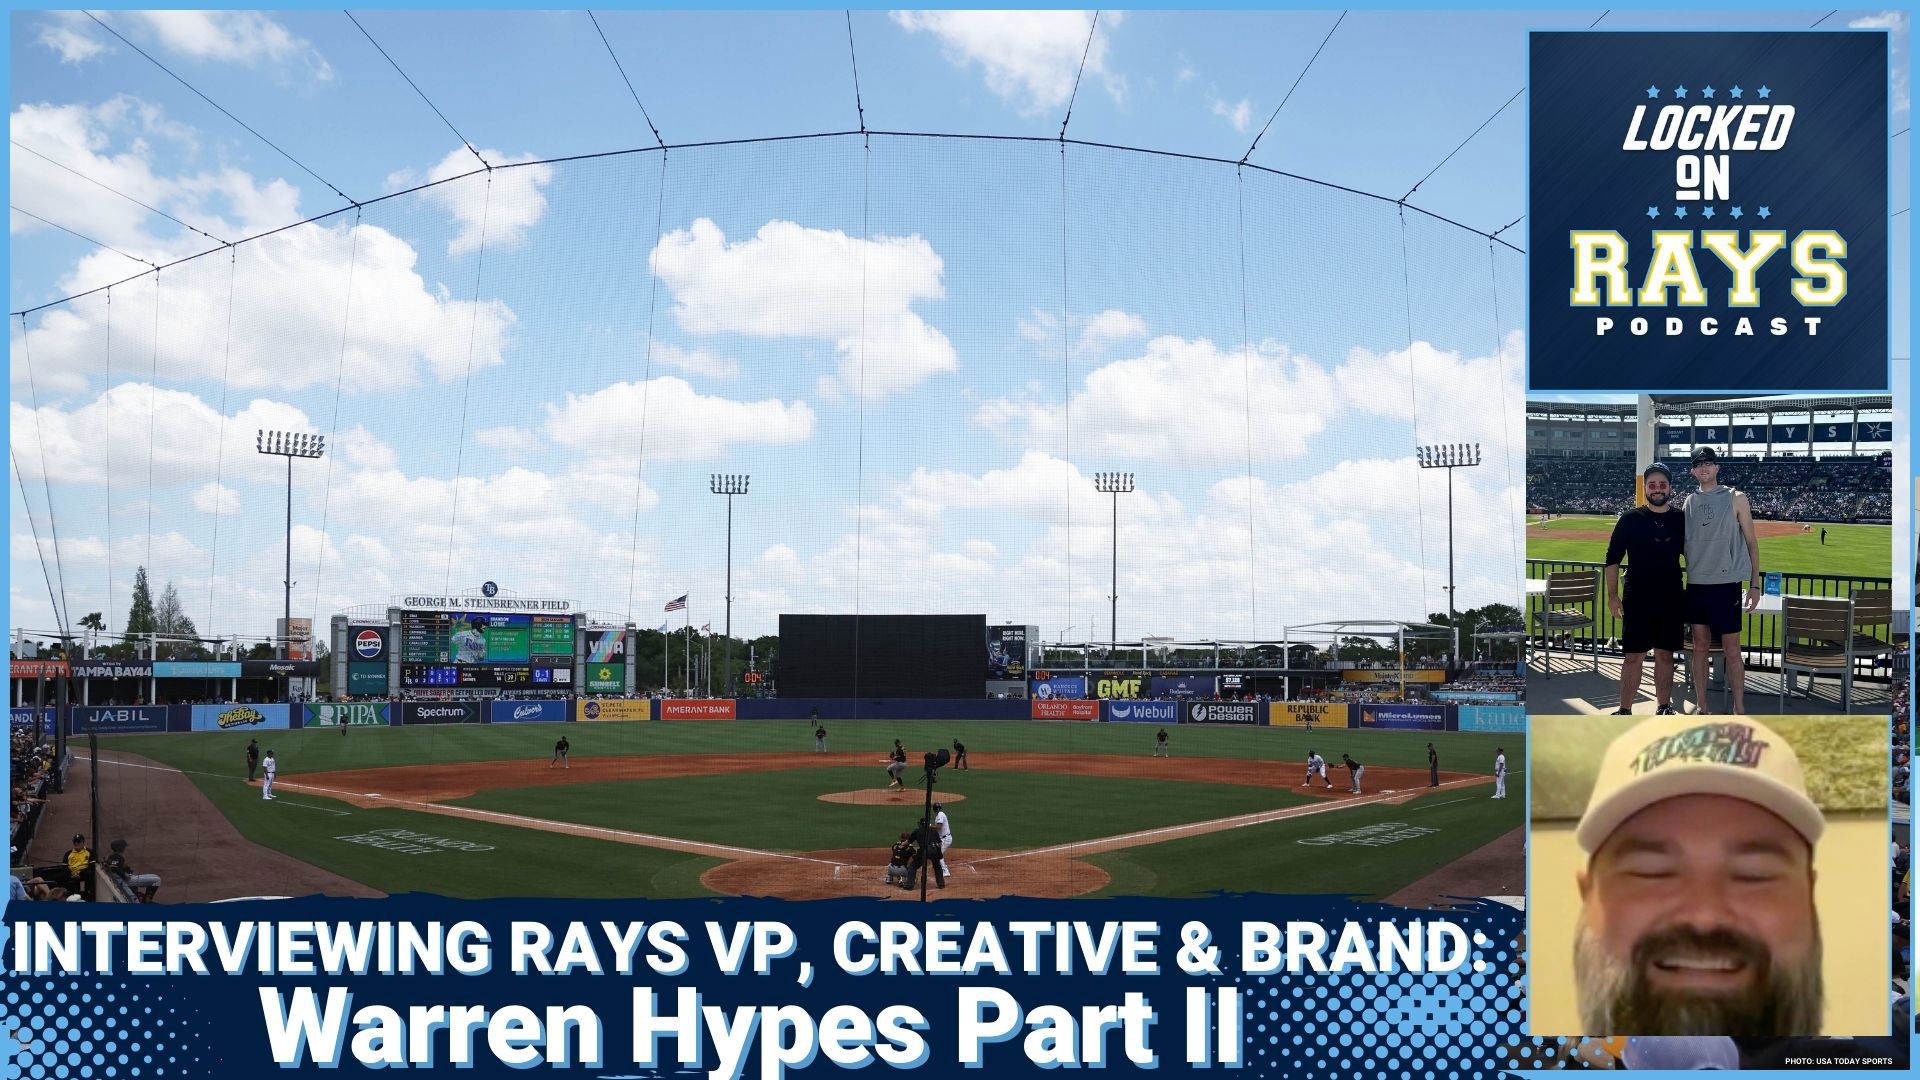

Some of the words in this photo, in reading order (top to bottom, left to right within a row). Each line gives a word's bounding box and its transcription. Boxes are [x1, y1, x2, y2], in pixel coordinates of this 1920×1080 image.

[404, 597, 447, 607] GEORGE
[449, 598, 461, 608] M.
[464, 599, 539, 610] STEINBRENNER
[541, 600, 570, 610] FIELD
[71, 666, 113, 677] TAMPA
[114, 666, 152, 677] BAY44
[417, 706, 465, 719] Spectrum
[666, 706, 709, 714] AMERANT
[1133, 706, 1174, 719] Webull
[1287, 705, 1329, 714] REPUBLIC
[89, 709, 150, 722] JABIL
[1295, 714, 1321, 723] BANK
[1378, 711, 1442, 720] MicroLumen
